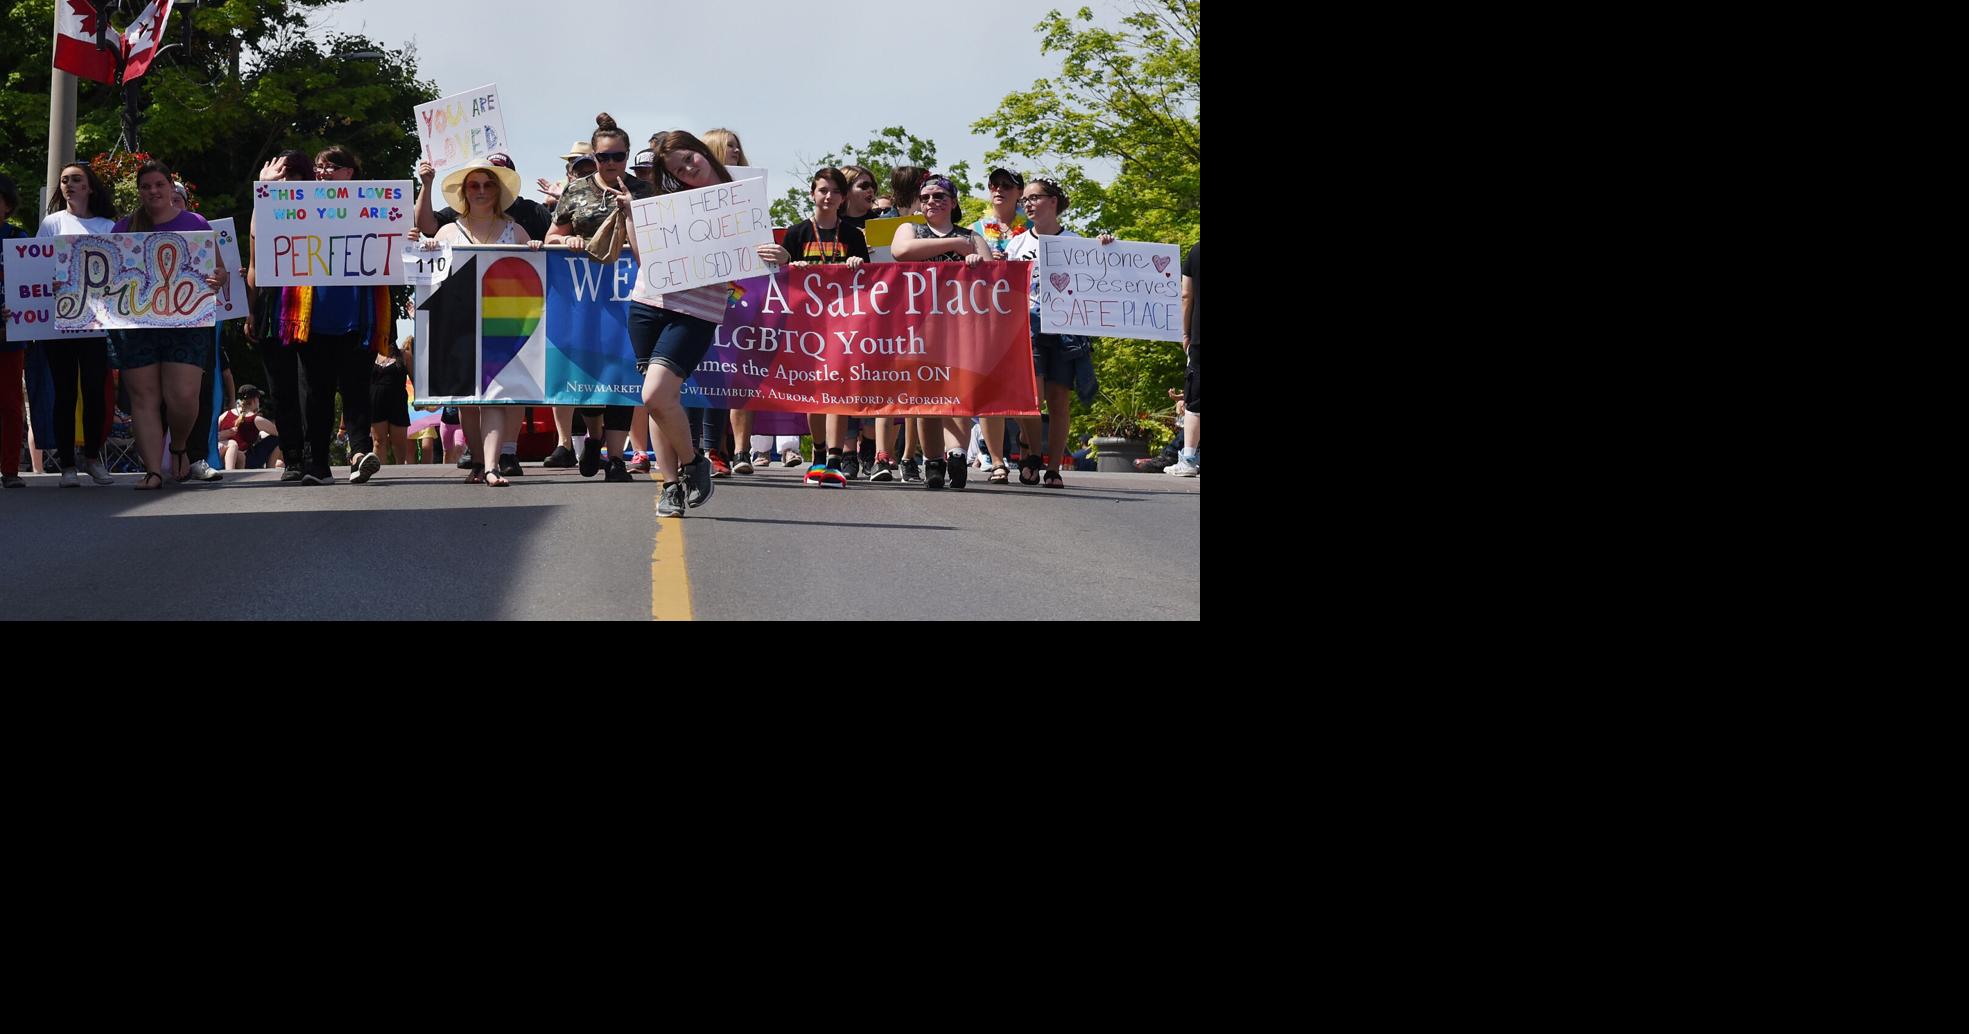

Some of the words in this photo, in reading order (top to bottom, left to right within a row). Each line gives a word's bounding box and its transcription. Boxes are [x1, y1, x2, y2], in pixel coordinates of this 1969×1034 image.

[422, 101, 469, 138] YOU
[270, 188, 305, 201] THIS
[314, 187, 349, 200] MOM
[358, 187, 402, 200] LOVES
[274, 208, 307, 220] WHO
[317, 207, 347, 219] YOU
[360, 206, 388, 219] ARE
[16, 244, 54, 258] YOU
[273, 232, 403, 278] PERFECT
[415, 256, 446, 273] 110
[1044, 241, 1150, 279] Everyone
[55, 243, 215, 320] Pride
[648, 255, 690, 290] GET
[693, 250, 733, 282] USED
[734, 246, 752, 273] TO
[762, 273, 794, 314] A
[803, 268, 890, 318] Safe
[902, 266, 1012, 316] Place
[1074, 272, 1178, 298] Deserves
[11, 309, 49, 324] YOU
[1050, 298, 1119, 328] SAFE
[1122, 300, 1178, 331] PLACE
[713, 325, 827, 362] LGBTQ
[833, 325, 928, 355] Youth
[742, 358, 769, 378] the
[774, 363, 845, 386] Apostle,
[850, 362, 912, 382] Sharon
[917, 366, 952, 382] ON
